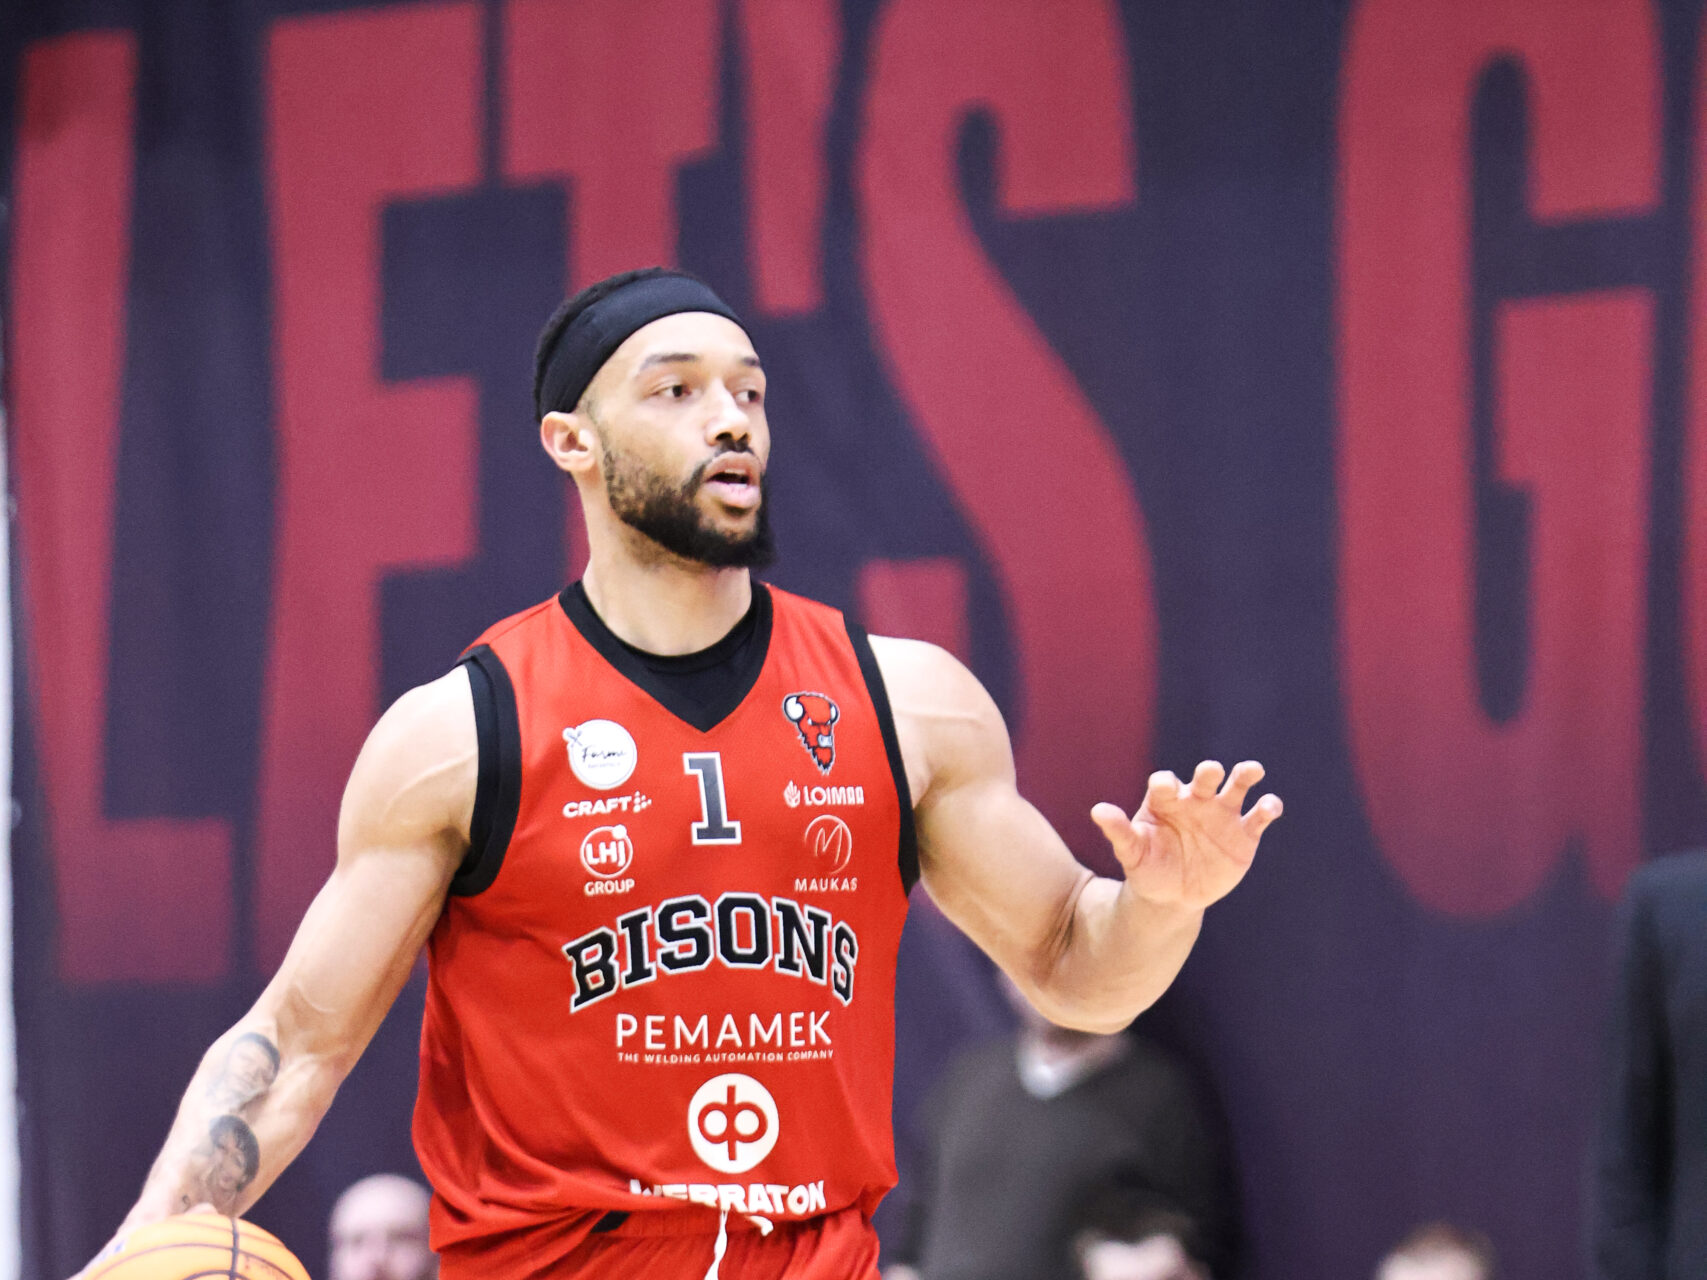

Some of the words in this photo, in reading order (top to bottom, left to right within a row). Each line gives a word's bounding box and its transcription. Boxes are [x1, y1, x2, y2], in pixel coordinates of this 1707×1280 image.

[1333, 0, 1707, 925] G
[562, 796, 632, 818] CRAFT
[682, 752, 742, 845] 1
[586, 840, 626, 867] LHJ
[584, 878, 635, 896] GROUP
[794, 877, 858, 892] MAUKAS
[562, 891, 858, 1014] BISONS
[616, 1010, 832, 1050] PEMAMEK
[618, 1052, 638, 1063] THE
[644, 1053, 700, 1064] WELDING
[705, 1051, 783, 1063] AUTOMATION
[787, 1049, 834, 1061] COMPANY
